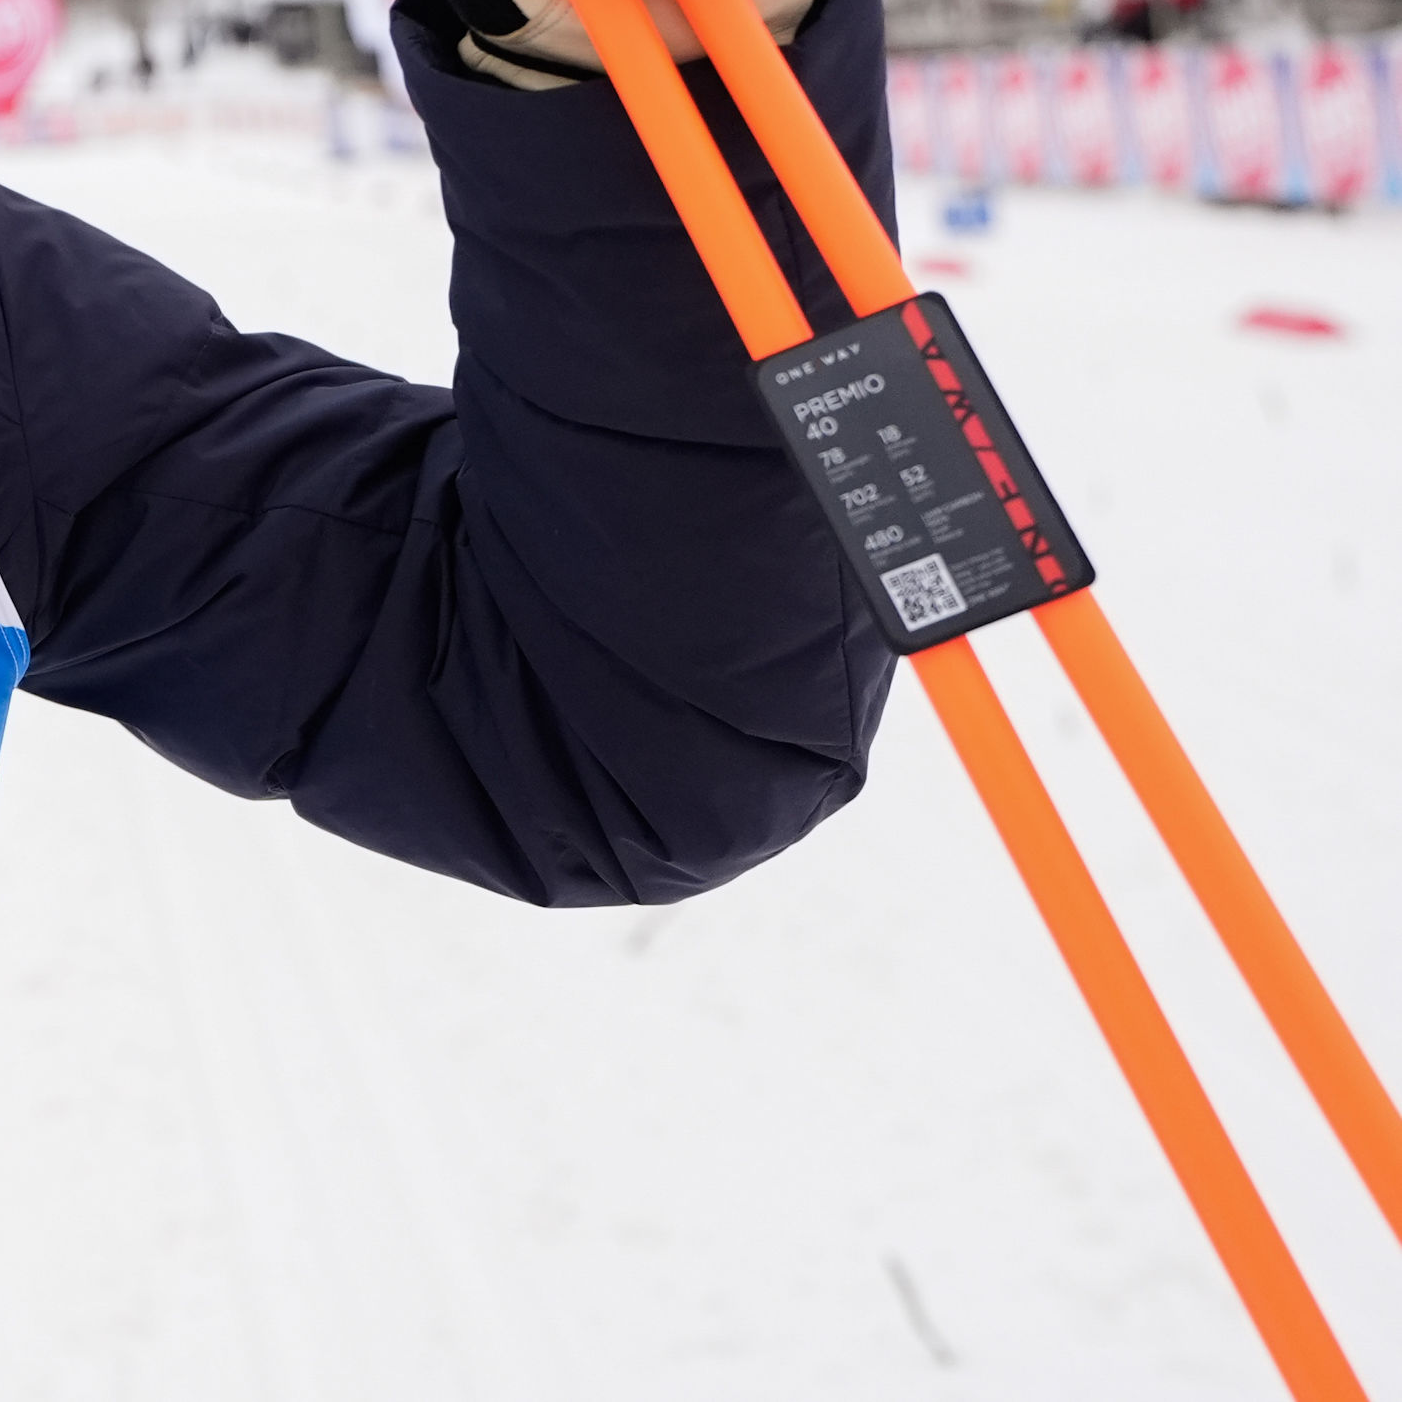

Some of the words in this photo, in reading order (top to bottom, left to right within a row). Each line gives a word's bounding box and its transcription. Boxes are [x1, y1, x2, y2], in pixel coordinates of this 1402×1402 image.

[775, 360, 816, 386] ONE
[820, 340, 860, 366] WAY
[793, 373, 886, 424] PREMIO
[806, 416, 838, 440] 40
